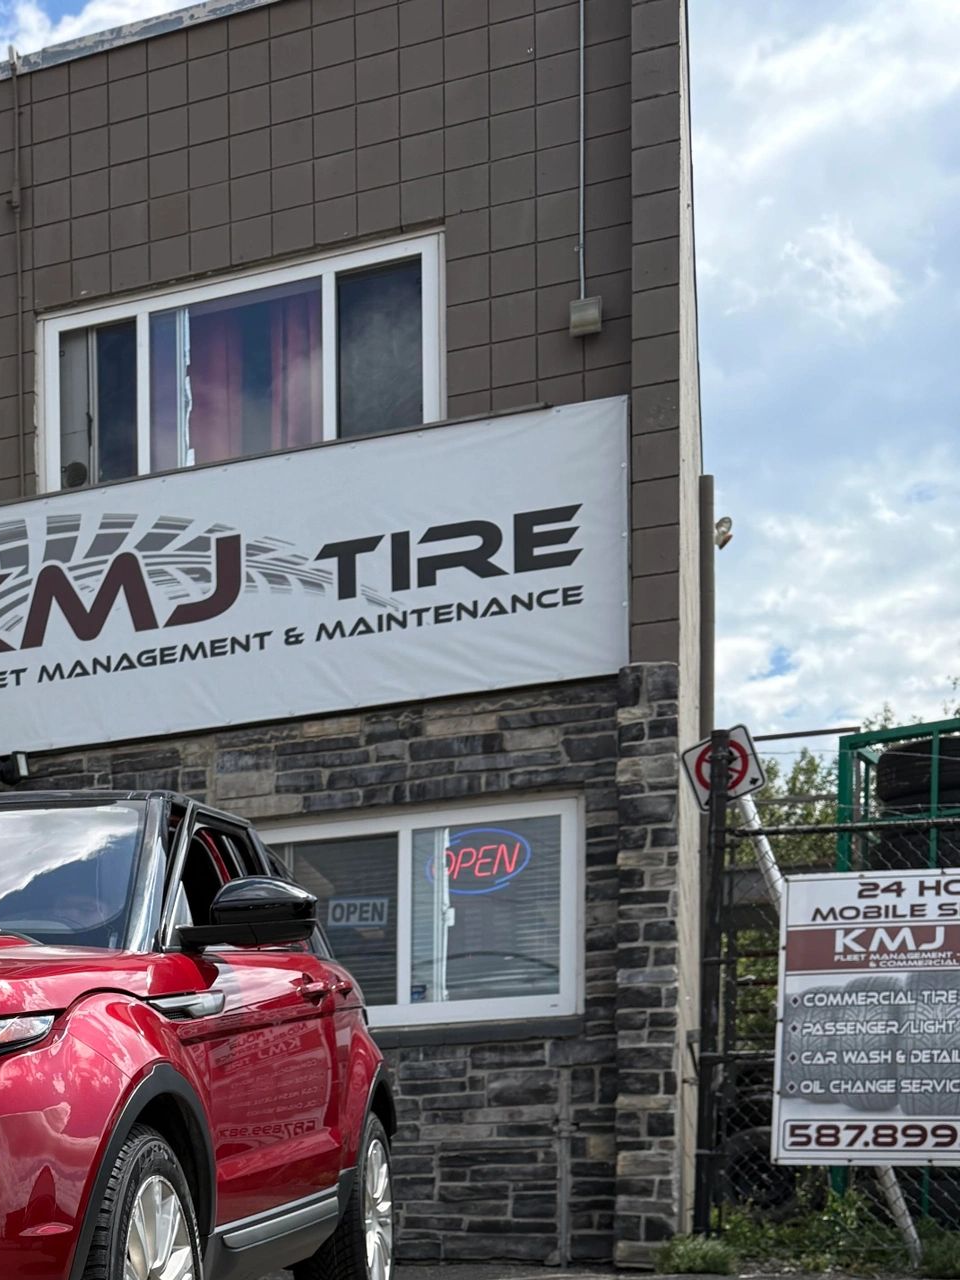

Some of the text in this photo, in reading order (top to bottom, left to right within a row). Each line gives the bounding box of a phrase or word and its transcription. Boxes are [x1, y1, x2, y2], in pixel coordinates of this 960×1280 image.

[313, 503, 584, 601] TIRE
[37, 630, 274, 684] MANAGEMENT
[283, 626, 305, 646] &
[315, 585, 584, 642] MAINTENANCE
[432, 842, 521, 880] OPEN
[857, 881, 906, 899] 24
[331, 901, 385, 923] OPEN
[811, 902, 960, 922] MOBILE S
[834, 926, 945, 953] KMJ
[833, 951, 953, 962] FLEET MANAGEMENT
[879, 958, 960, 968] COMMERCIAL
[803, 991, 917, 1007] COMMERCIAL
[802, 1020, 957, 1036] PASSENGER/LIGHT
[800, 1051, 838, 1065] CAR
[842, 1050, 892, 1065] WASH
[895, 1050, 906, 1064] &
[799, 1080, 826, 1094] OIL
[829, 1079, 897, 1094] CHANGE
[788, 1124, 960, 1148] 587.899
